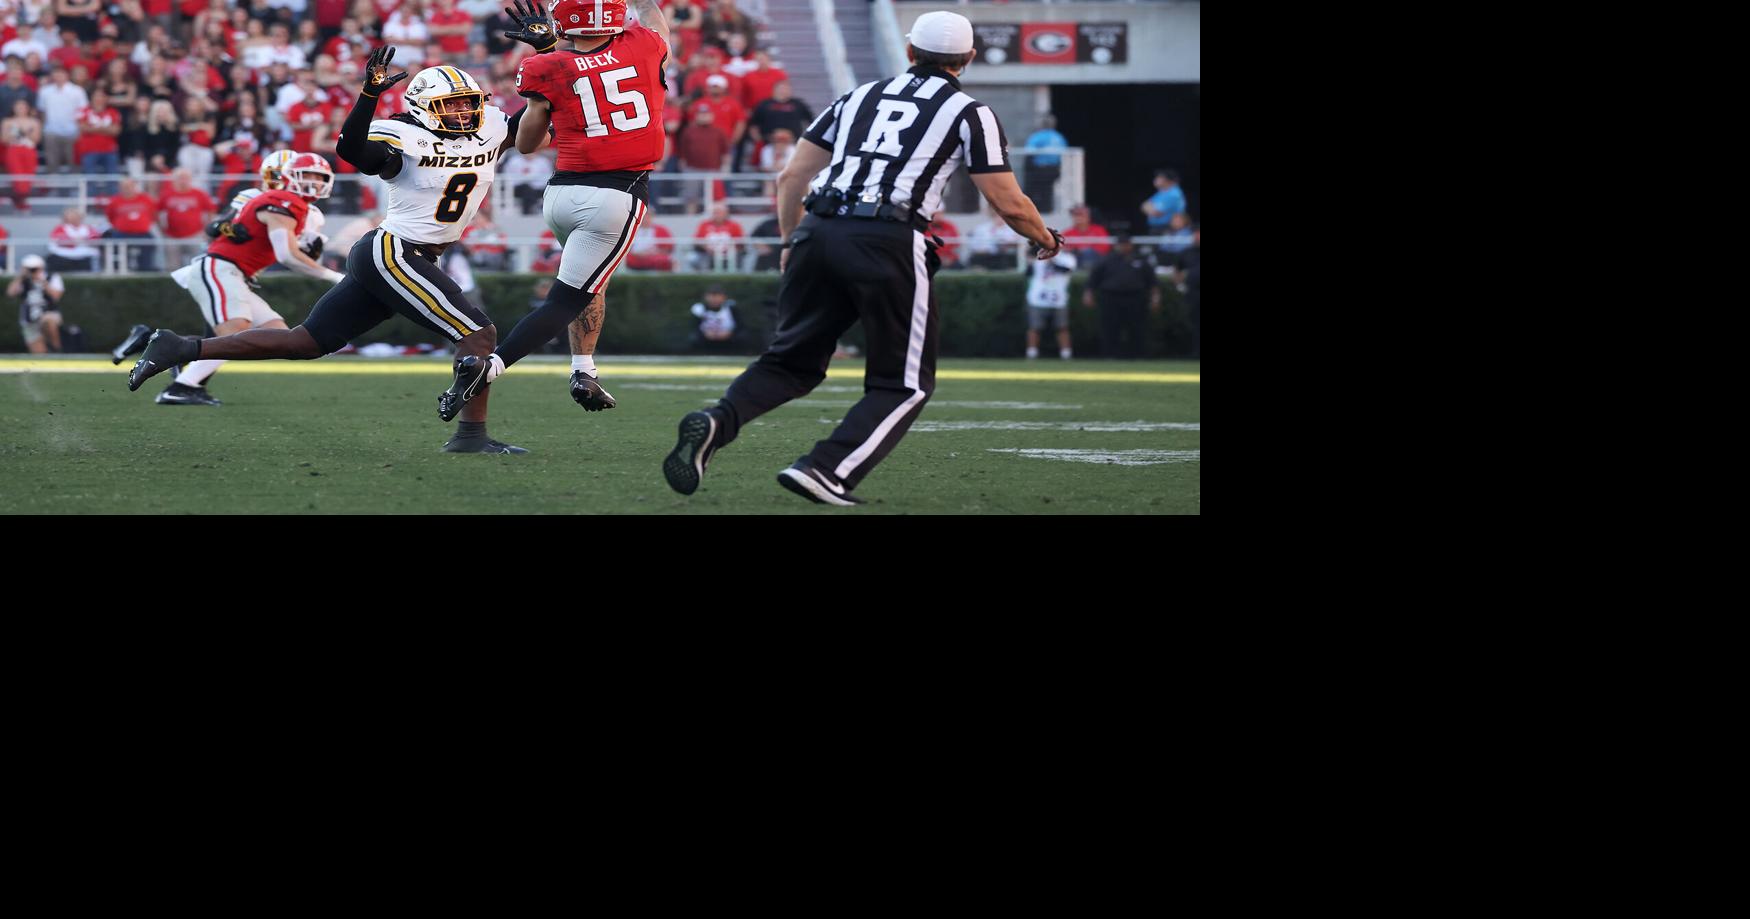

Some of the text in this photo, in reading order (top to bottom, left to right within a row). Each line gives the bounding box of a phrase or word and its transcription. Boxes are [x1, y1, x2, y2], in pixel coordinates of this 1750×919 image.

[574, 50, 620, 71] BECK
[572, 65, 651, 138] 15
[859, 98, 920, 158] R
[418, 147, 499, 168] MIZZOU
[432, 141, 446, 155] C
[433, 171, 479, 225] 8
